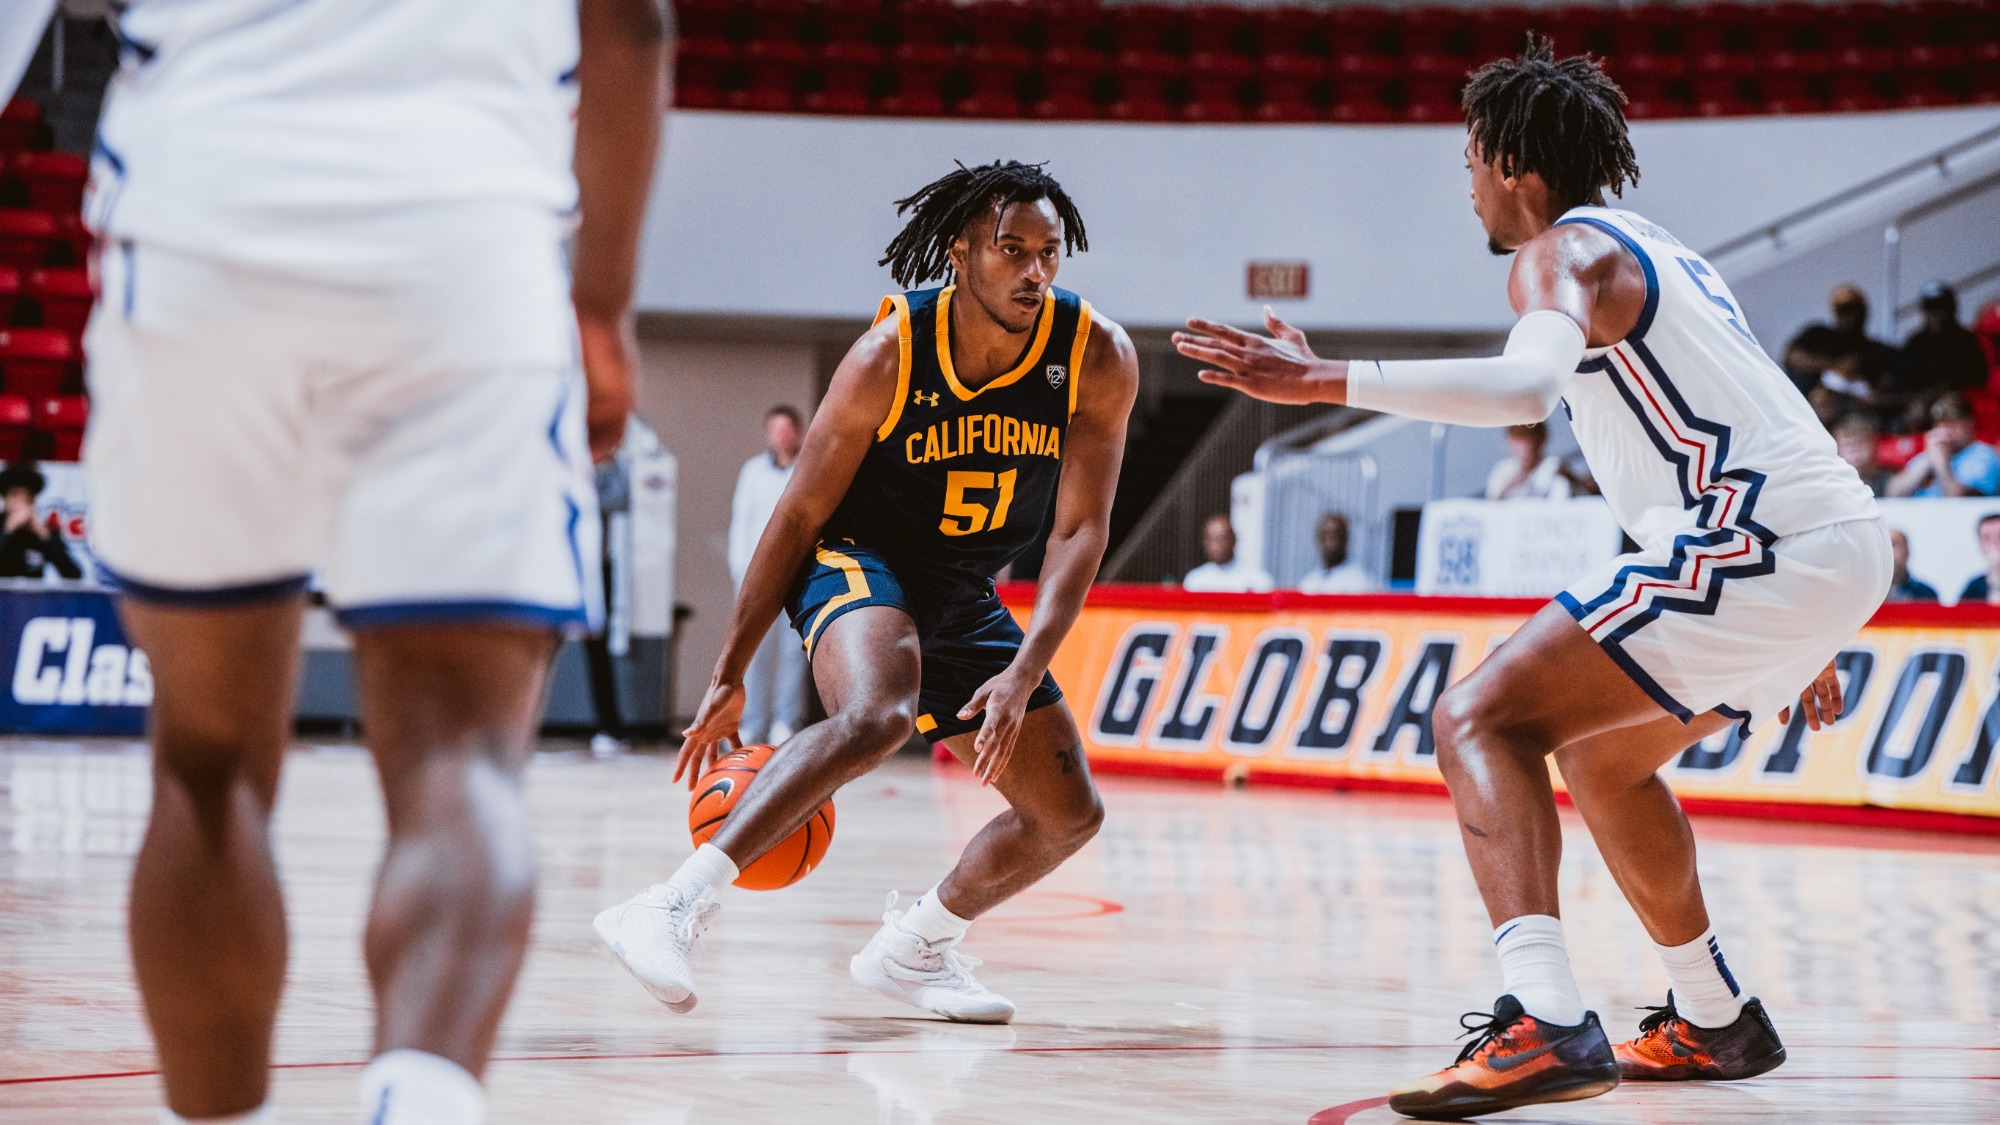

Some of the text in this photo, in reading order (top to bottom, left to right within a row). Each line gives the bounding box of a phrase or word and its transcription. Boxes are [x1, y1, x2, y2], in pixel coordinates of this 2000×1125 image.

[1046, 365, 1066, 380] PAC
[1051, 374, 1060, 384] 12
[905, 413, 1060, 464] CALIFORNIA
[938, 468, 1018, 537] 51
[1095, 628, 1502, 761] GLOBA
